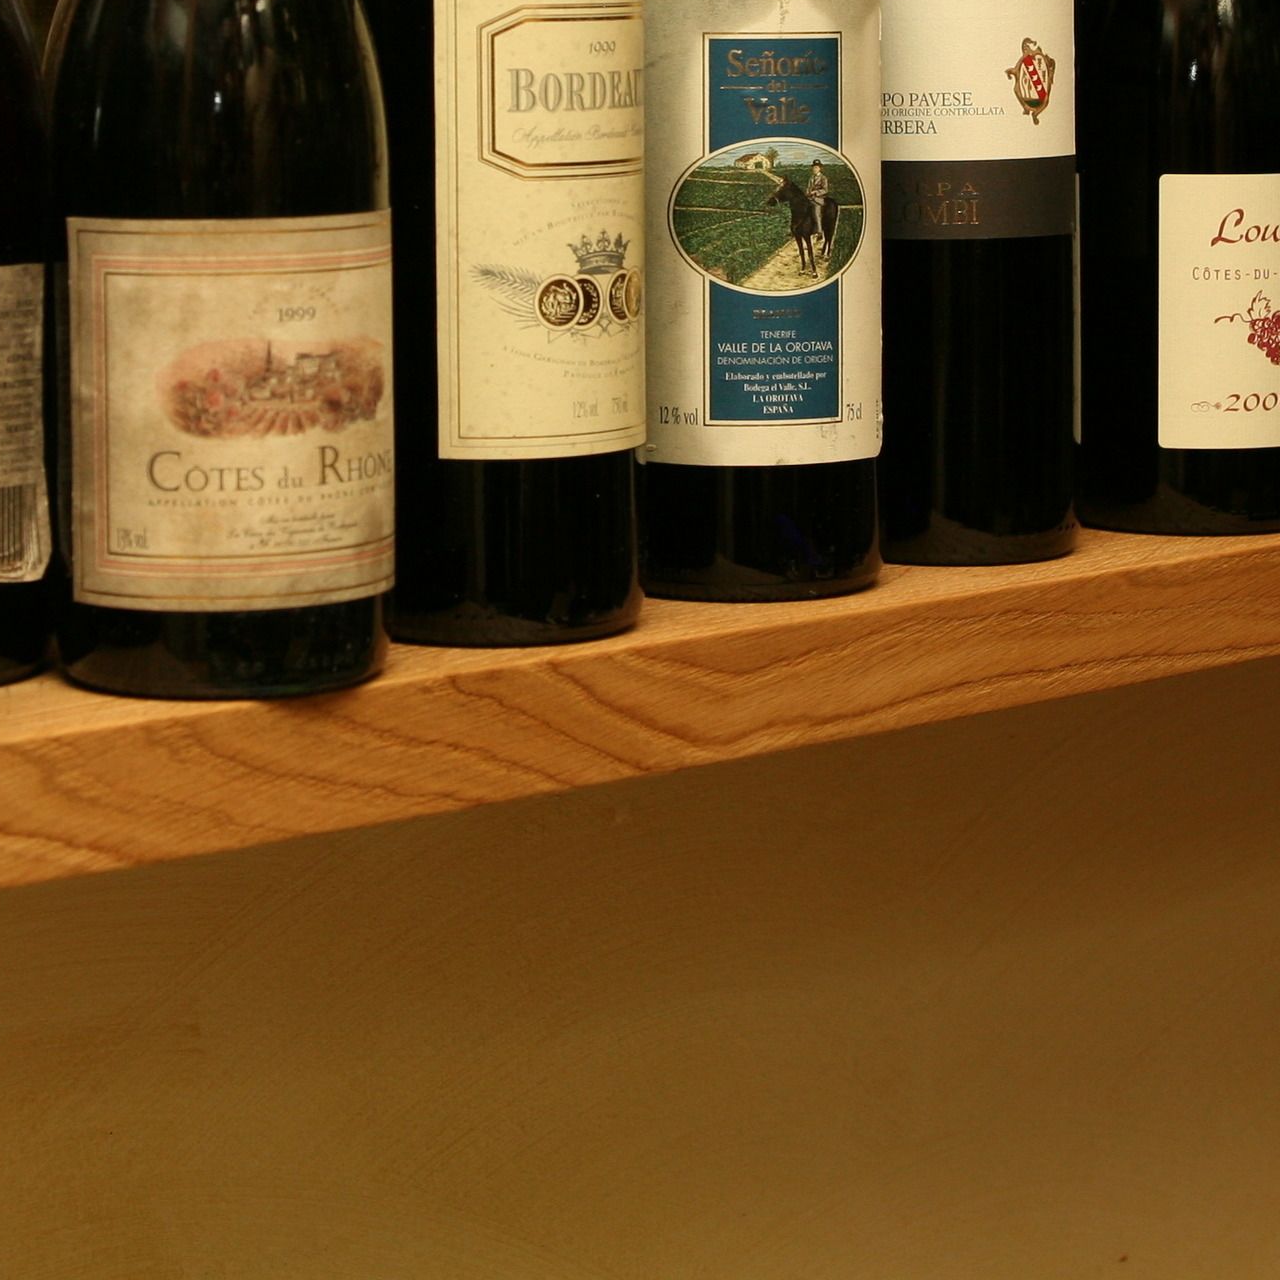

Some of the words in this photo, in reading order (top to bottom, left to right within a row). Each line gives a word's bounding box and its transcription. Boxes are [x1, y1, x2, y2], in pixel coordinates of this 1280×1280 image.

[881, 92, 905, 107] PO
[909, 91, 973, 107] PAVESE
[892, 107, 932, 117] ORIGINE
[933, 106, 1006, 117] CONTROLLATA
[278, 305, 317, 323] 1999
[760, 330, 797, 339] TENERIFE
[717, 342, 748, 354] VALLE
[752, 342, 766, 354] DE
[770, 342, 782, 353] LA
[785, 340, 833, 353] OROTAVA
[792, 355, 802, 365] DE
[815, 371, 827, 382] por
[743, 382, 770, 393] Bodega
[752, 394, 765, 403] LA
[766, 393, 804, 403] OROTAVA
[763, 403, 794, 415] ESPAÑA
[683, 407, 700, 426] vol
[147, 450, 266, 493] CÔTES
[277, 466, 304, 489] du
